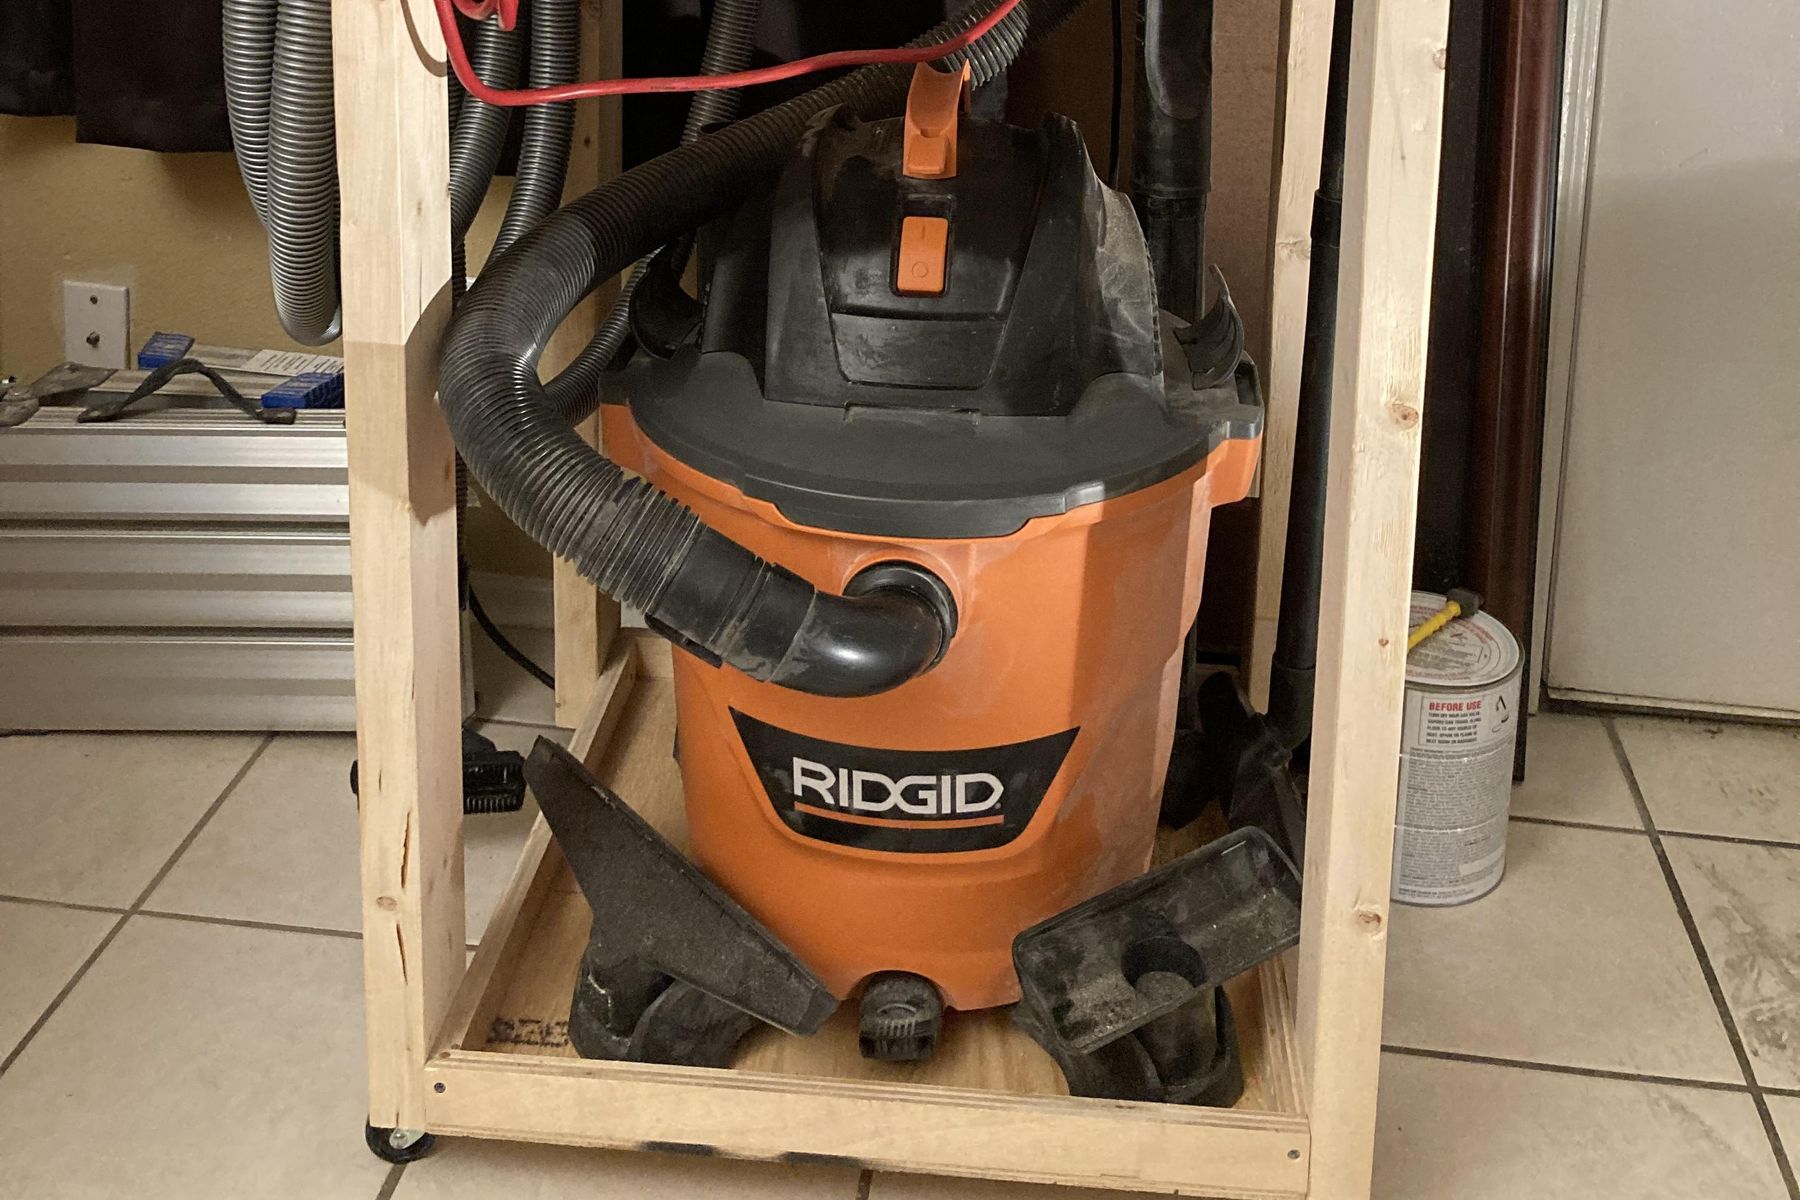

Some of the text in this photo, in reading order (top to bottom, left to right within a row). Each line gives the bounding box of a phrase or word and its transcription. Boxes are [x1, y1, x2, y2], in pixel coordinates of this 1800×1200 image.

[1429, 700, 1482, 711] BEFORE USE
[792, 757, 1004, 815] RIDGID
